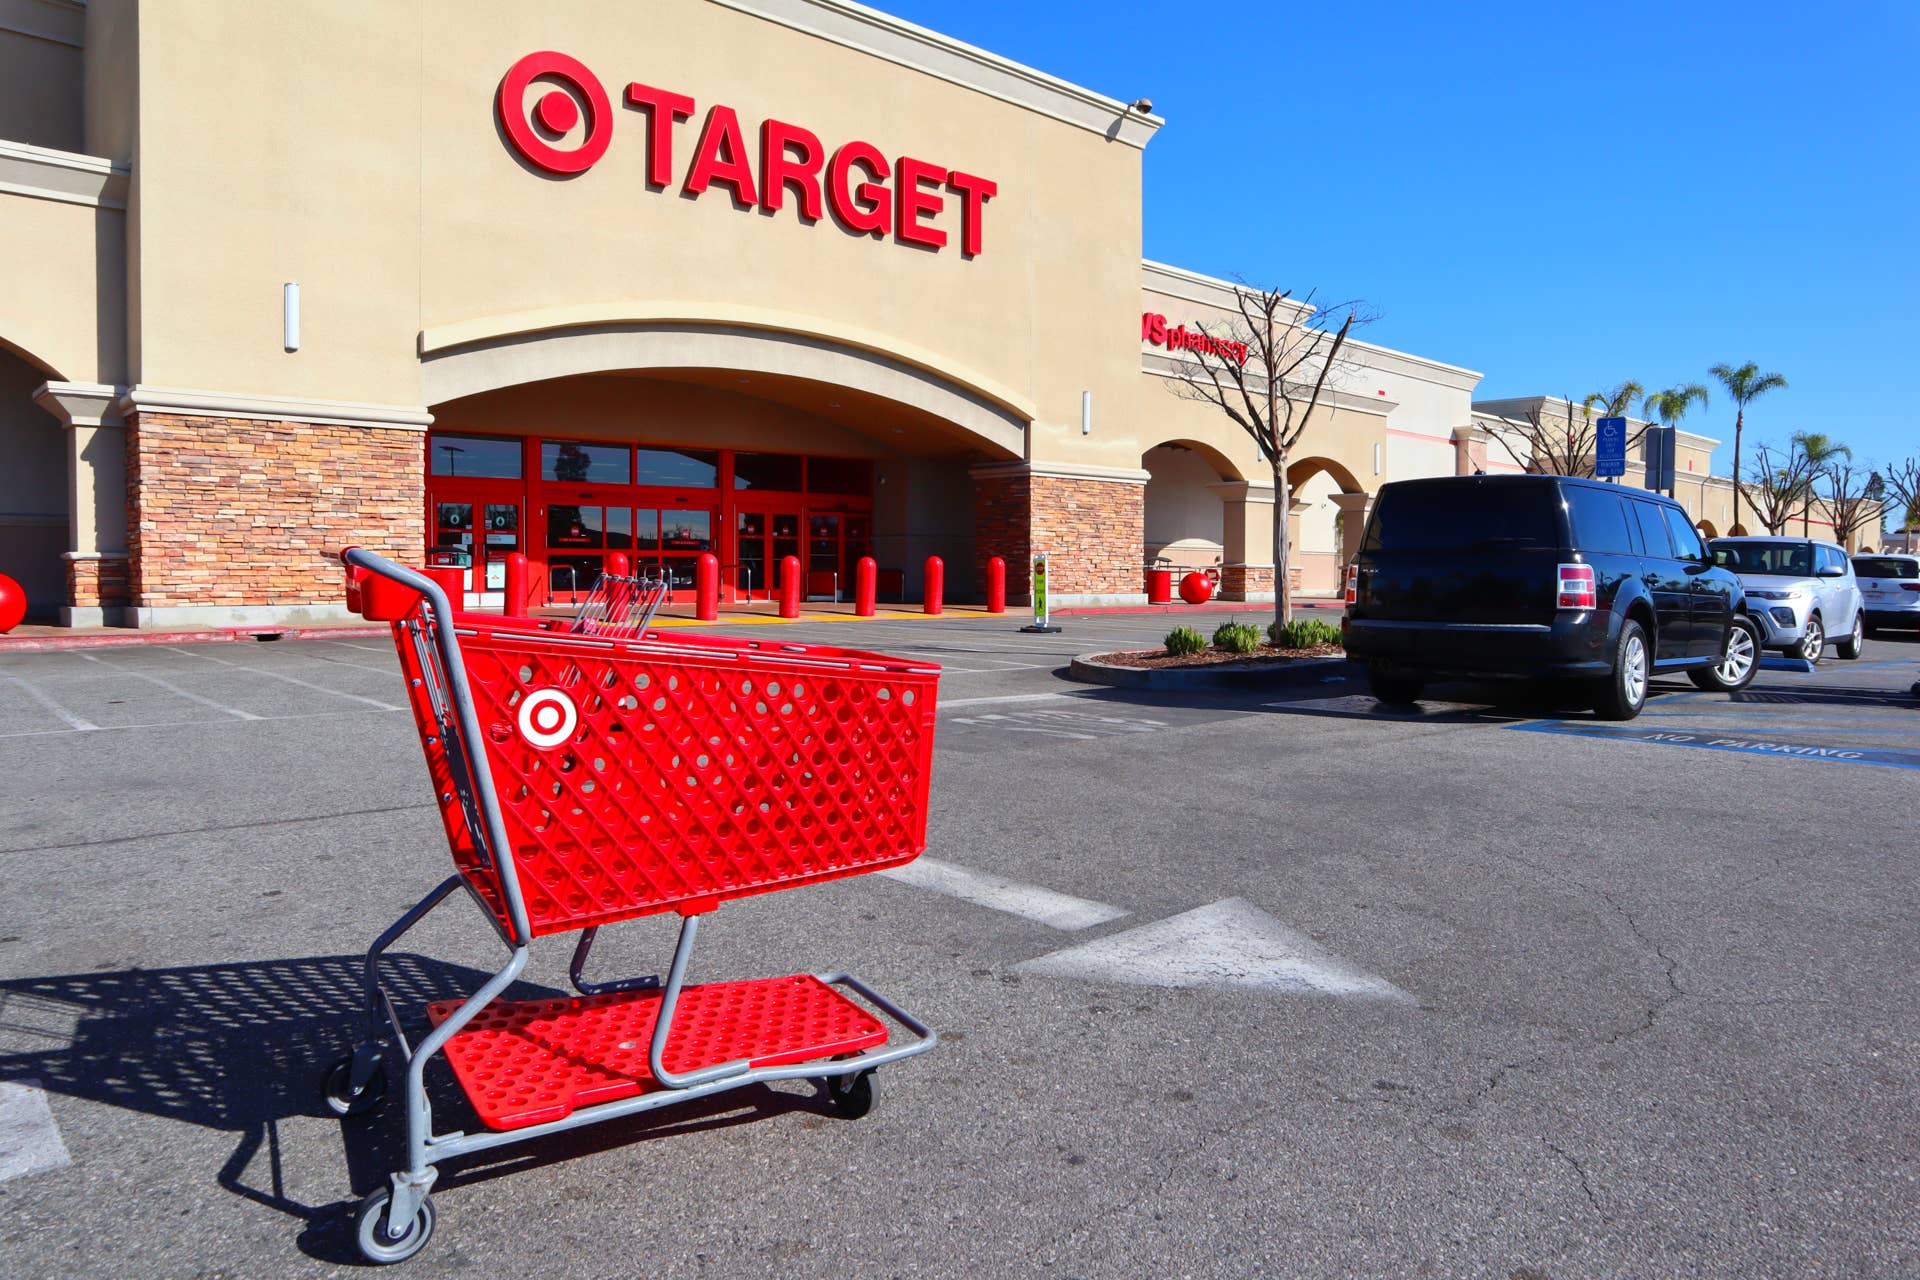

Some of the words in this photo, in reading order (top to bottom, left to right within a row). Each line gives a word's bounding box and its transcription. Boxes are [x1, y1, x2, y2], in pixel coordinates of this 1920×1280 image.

[623, 81, 998, 257] TARGET
[1642, 733, 1696, 742] NO
[1705, 739, 1865, 759] PARKING
